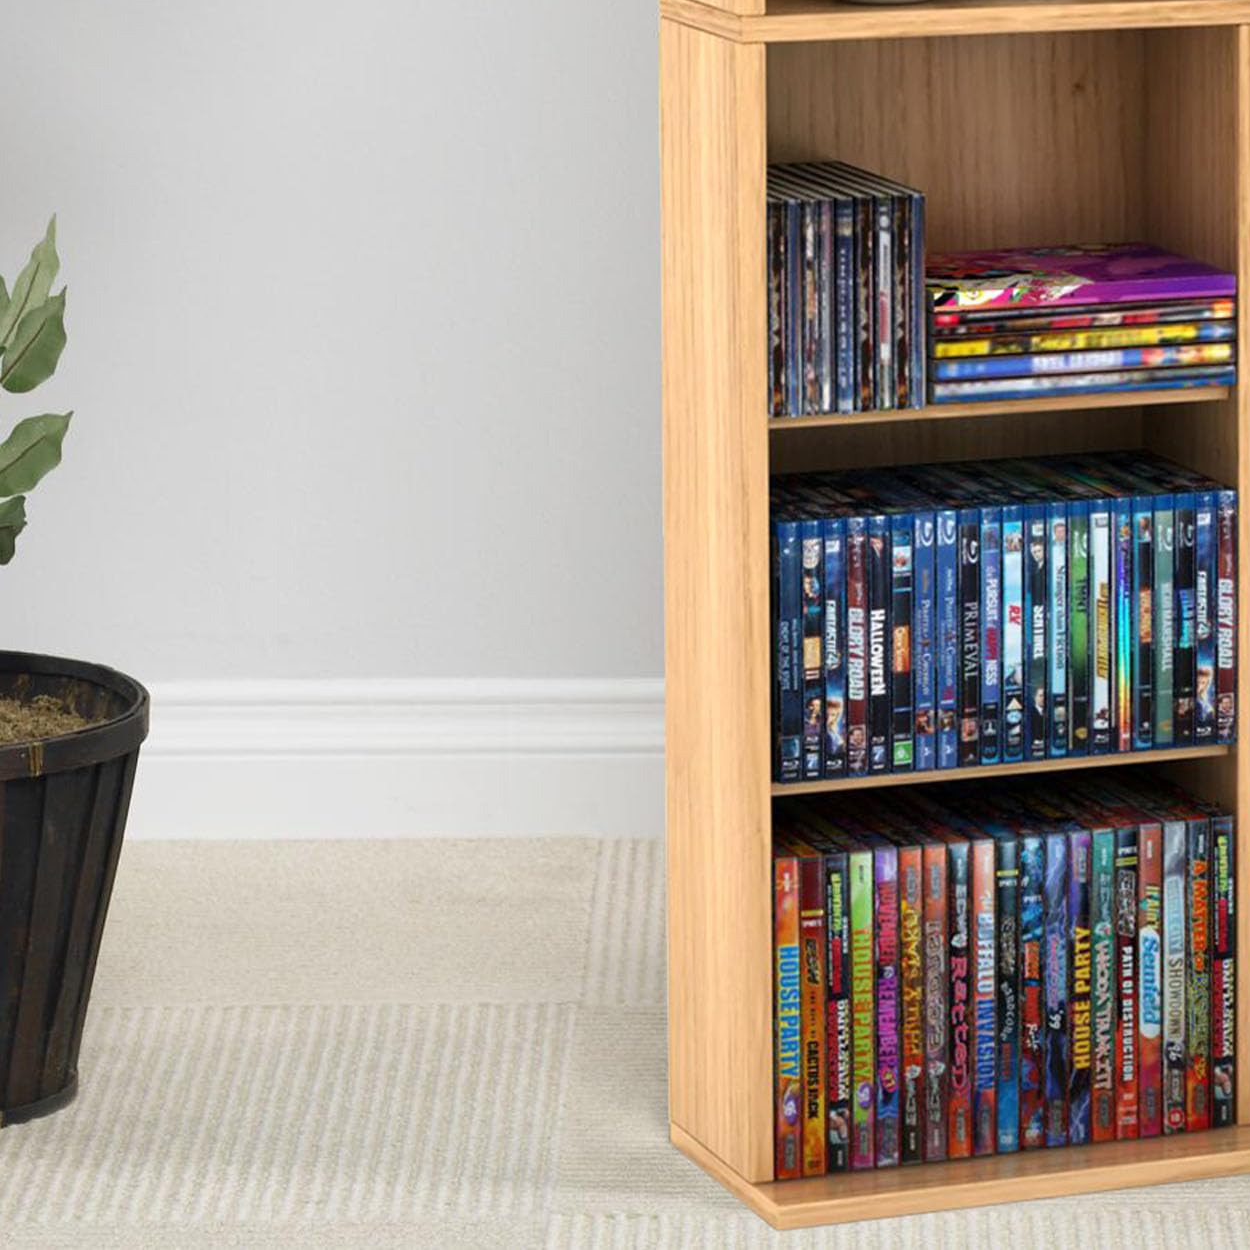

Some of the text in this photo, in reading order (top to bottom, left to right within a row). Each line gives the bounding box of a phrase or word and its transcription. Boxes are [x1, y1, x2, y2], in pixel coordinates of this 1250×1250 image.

[964, 602, 977, 680] PRIMEVAL
[986, 579, 998, 621] PURSUIT
[1009, 606, 1020, 625] RV
[1161, 610, 1173, 671] MARSHALL
[1218, 578, 1232, 669] GLORY ROAD
[848, 608, 864, 700] GLORY ROAD
[871, 609, 885, 696] HALLOWEEN
[1192, 860, 1208, 951] A MATTER
[878, 882, 896, 1066] NOVEMBER REMEMBER
[976, 912, 995, 1092] BUFFALO INVASION
[1075, 926, 1090, 1069] HOUSE PARTY
[1122, 980, 1133, 994] OF
[1123, 946, 1133, 977] PATH
[1141, 937, 1160, 1025] Seinfeld
[1168, 957, 1183, 1037] SHOWDOWN
[780, 946, 800, 1077] HOUSE PARTY
[853, 931, 872, 1078] HOUSE PARTY
[1000, 981, 1015, 1041] HARDCORE
[1122, 999, 1133, 1081] DESTRUCTION
[807, 1041, 820, 1119] CACTUS JACK
